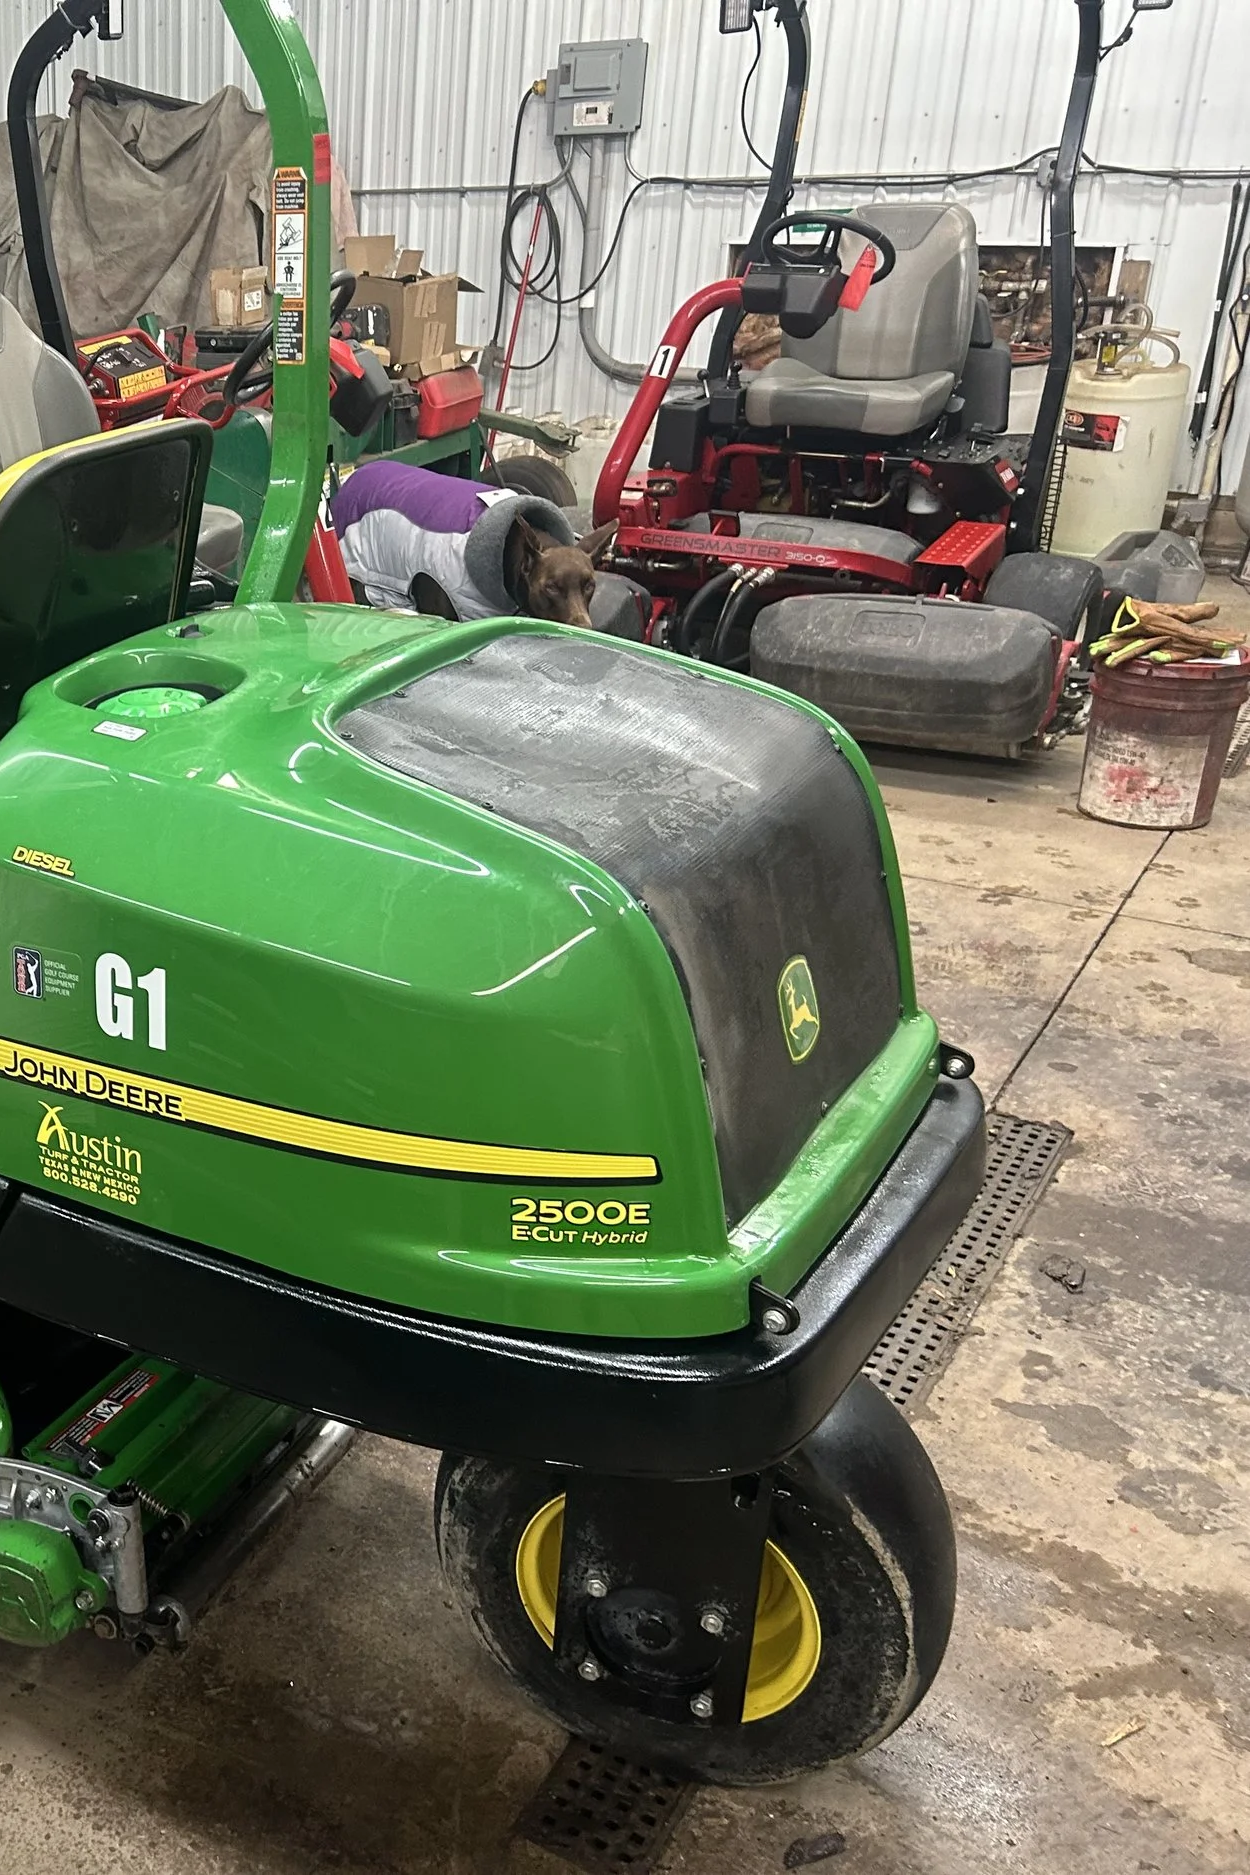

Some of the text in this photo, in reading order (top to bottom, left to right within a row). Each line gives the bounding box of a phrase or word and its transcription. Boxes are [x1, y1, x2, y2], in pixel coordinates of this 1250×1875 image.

[657, 347, 671, 376] 1
[640, 532, 782, 558] GREENSMASTER
[11, 845, 76, 878] DIESEL
[44, 959, 66, 971] OFFICIAL
[57, 971, 80, 982] COURSE
[44, 976, 76, 989] EQUIPMENT
[45, 985, 70, 997] SUPPLIER
[95, 952, 167, 1051] G1
[4, 1050, 183, 1118] JOHN DEERE
[36, 1100, 142, 1175] Austin
[38, 1155, 141, 1195] TEXAS & NEW MEXICO
[39, 1145, 139, 1185] TURF & TRACTOR
[42, 1166, 138, 1206] 800.528.4290
[511, 1198, 651, 1226] 2500E
[581, 1230, 649, 1246] Hybrid
